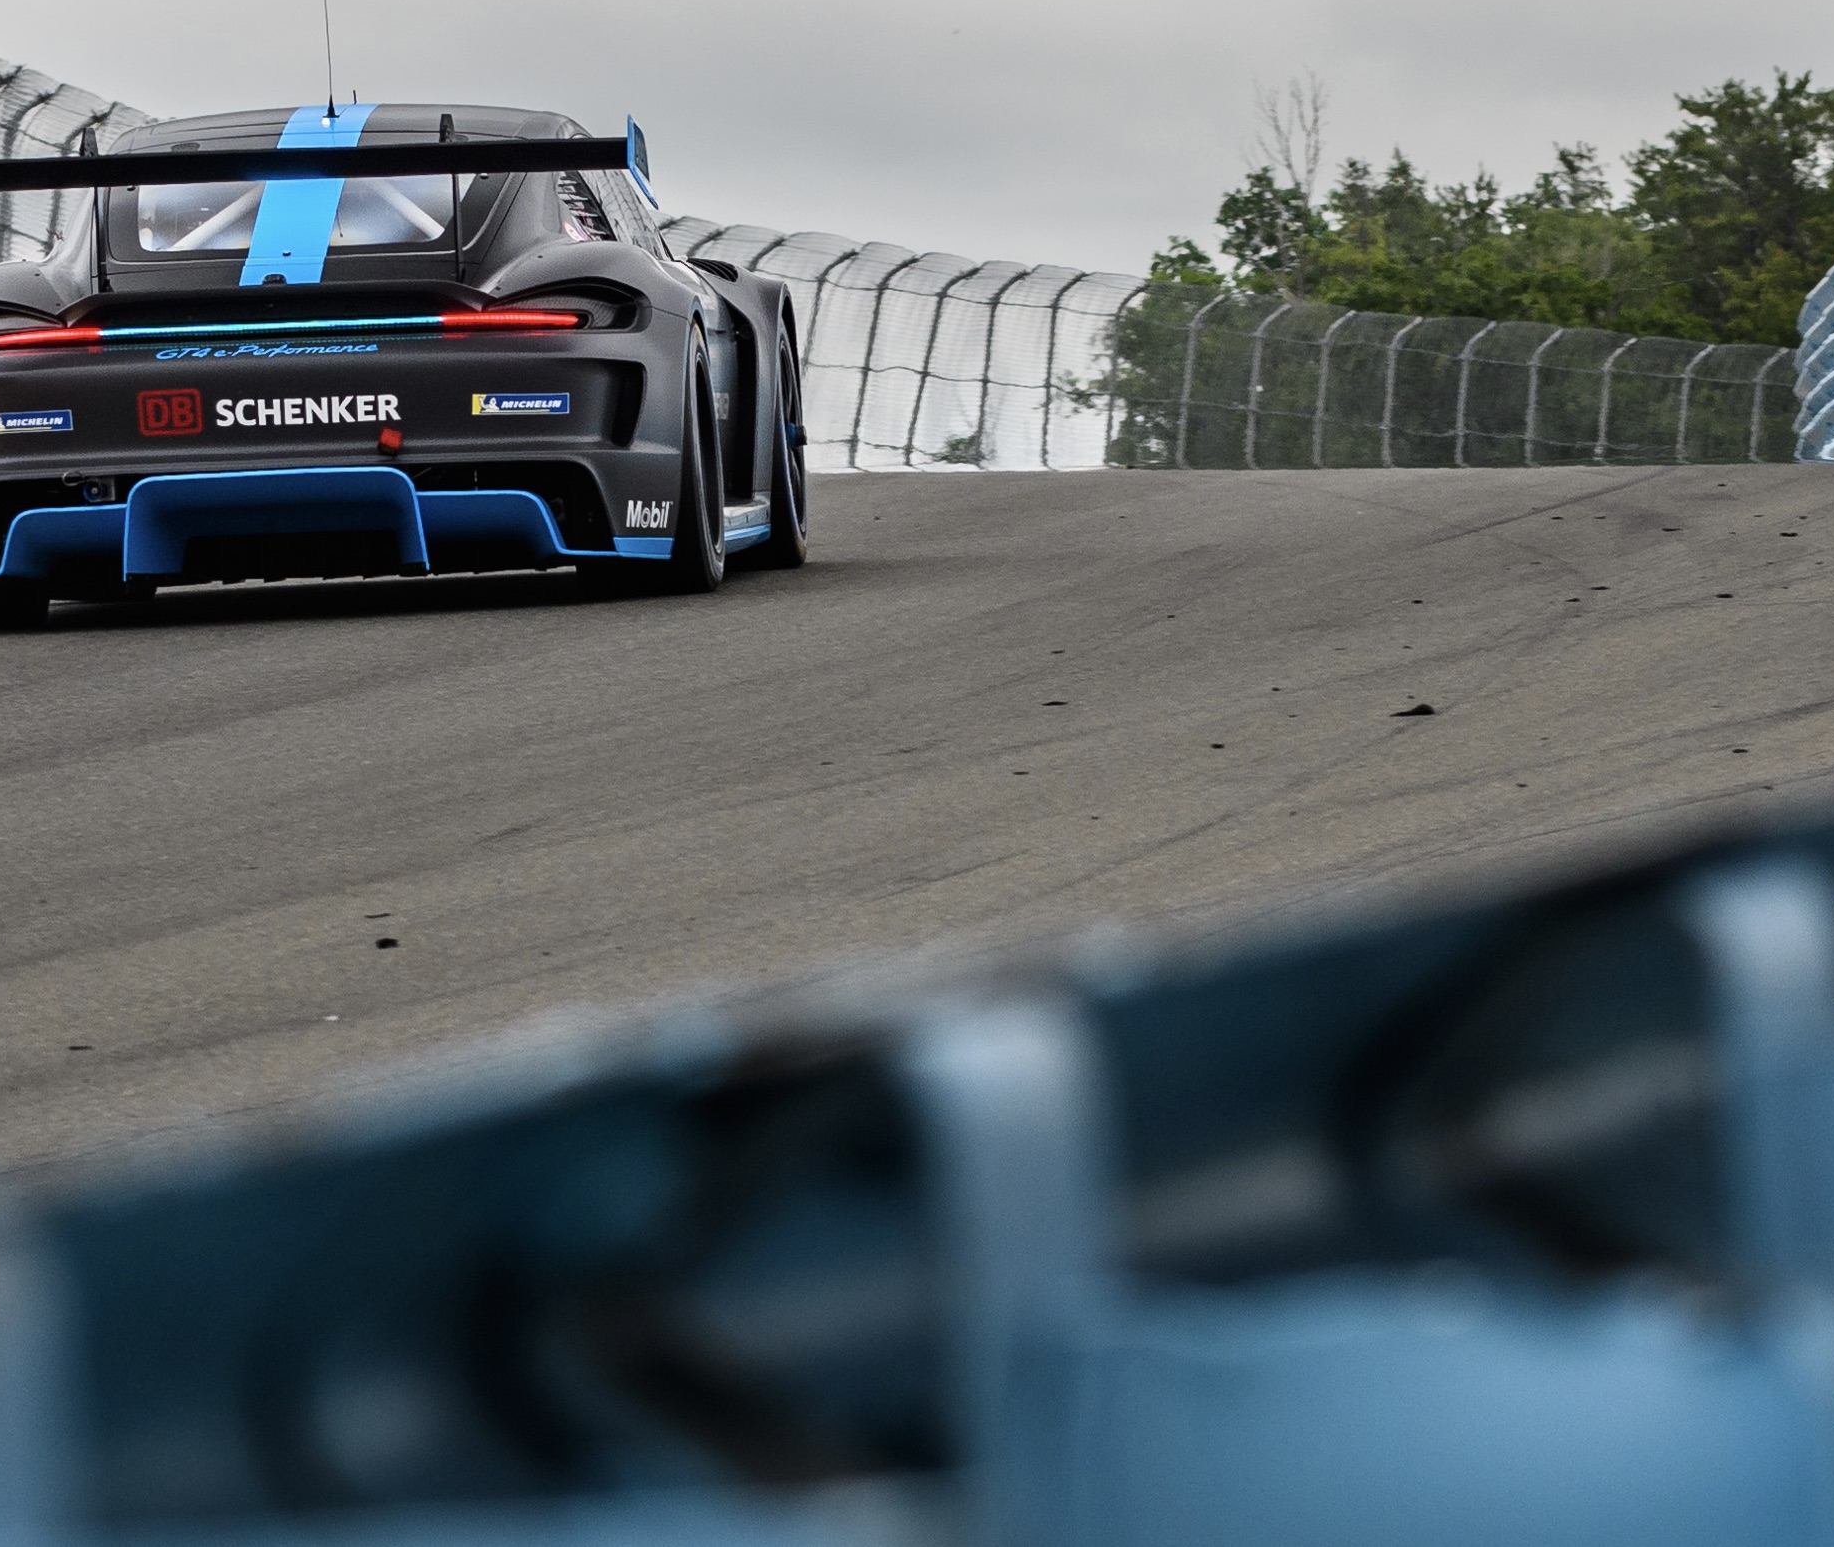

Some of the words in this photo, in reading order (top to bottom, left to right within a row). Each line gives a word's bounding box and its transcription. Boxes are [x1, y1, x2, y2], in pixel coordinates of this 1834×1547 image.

[155, 347, 212, 360] GT4
[213, 343, 378, 358] e-Performance
[146, 396, 195, 428] DB
[215, 394, 402, 427] SCHENKER
[500, 399, 563, 409] MICHELIN
[5, 416, 64, 427] MICHELIN
[626, 499, 670, 529] Mobil
